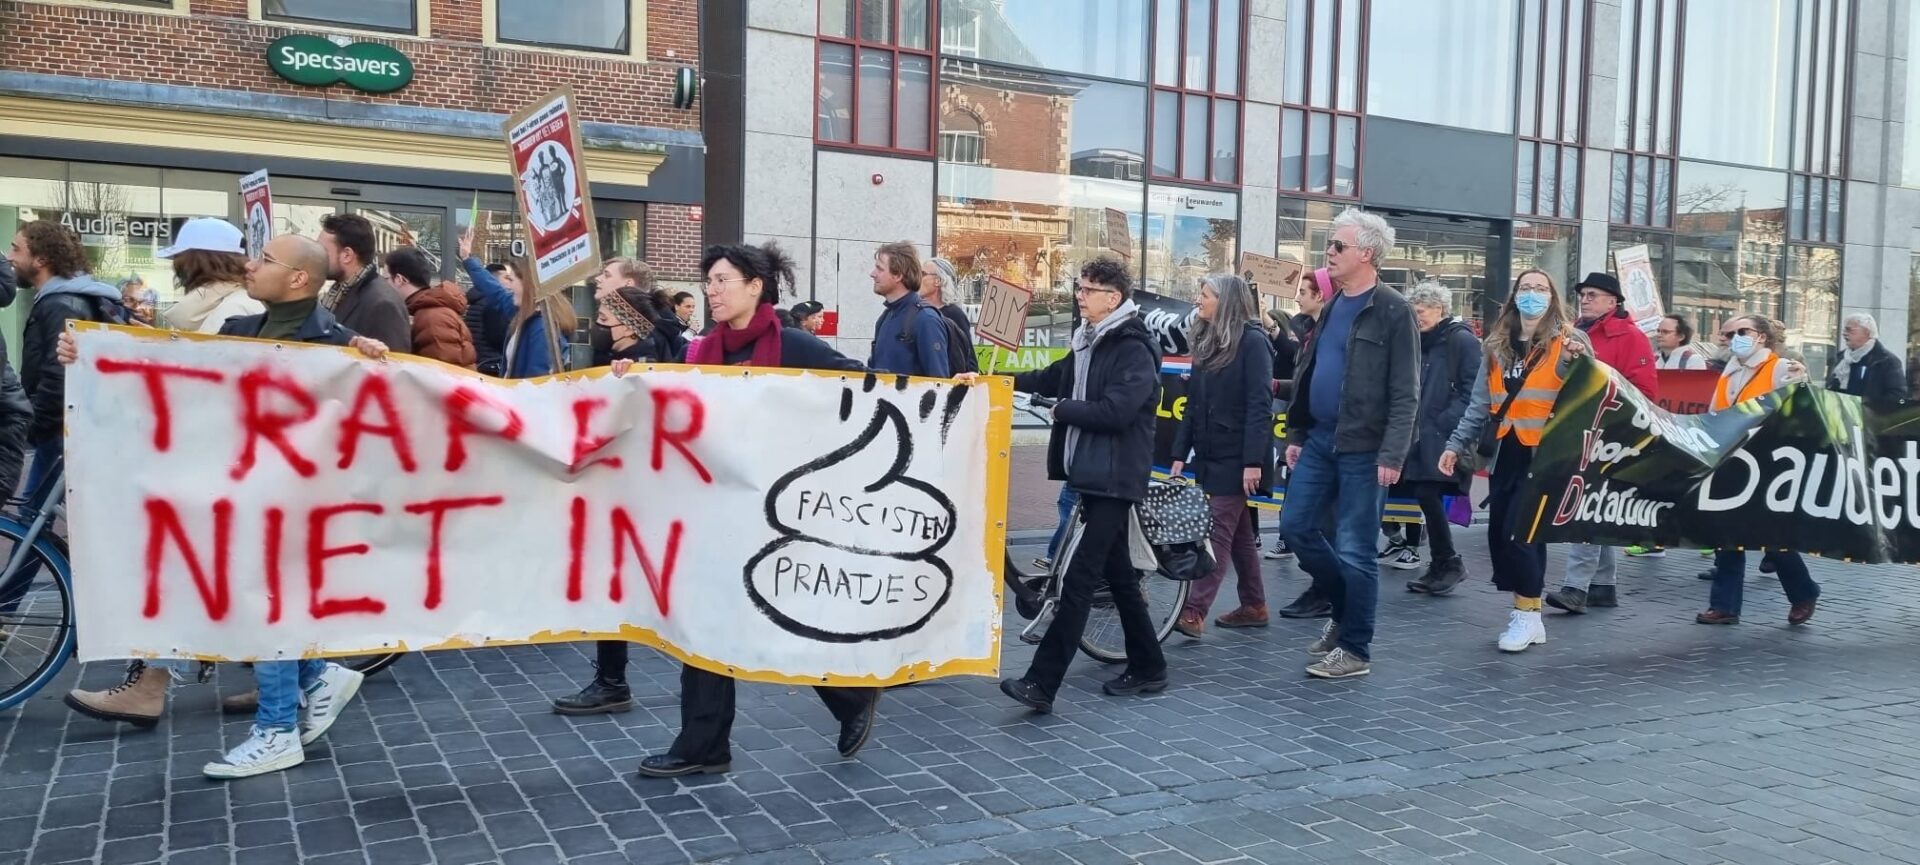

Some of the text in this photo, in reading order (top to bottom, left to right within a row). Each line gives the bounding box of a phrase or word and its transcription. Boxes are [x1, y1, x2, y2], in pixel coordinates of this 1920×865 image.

[281, 46, 400, 76] Specsavers
[1186, 196, 1224, 209] Leeuwarden
[982, 285, 1028, 341] BLM
[1005, 350, 1051, 369] AAN
[1579, 429, 1640, 471] Voor
[797, 490, 948, 540] FASCISTEN
[1552, 475, 1675, 528] Dictatuur
[142, 496, 684, 624] NIET IN
[775, 556, 931, 606] PRAATJES
